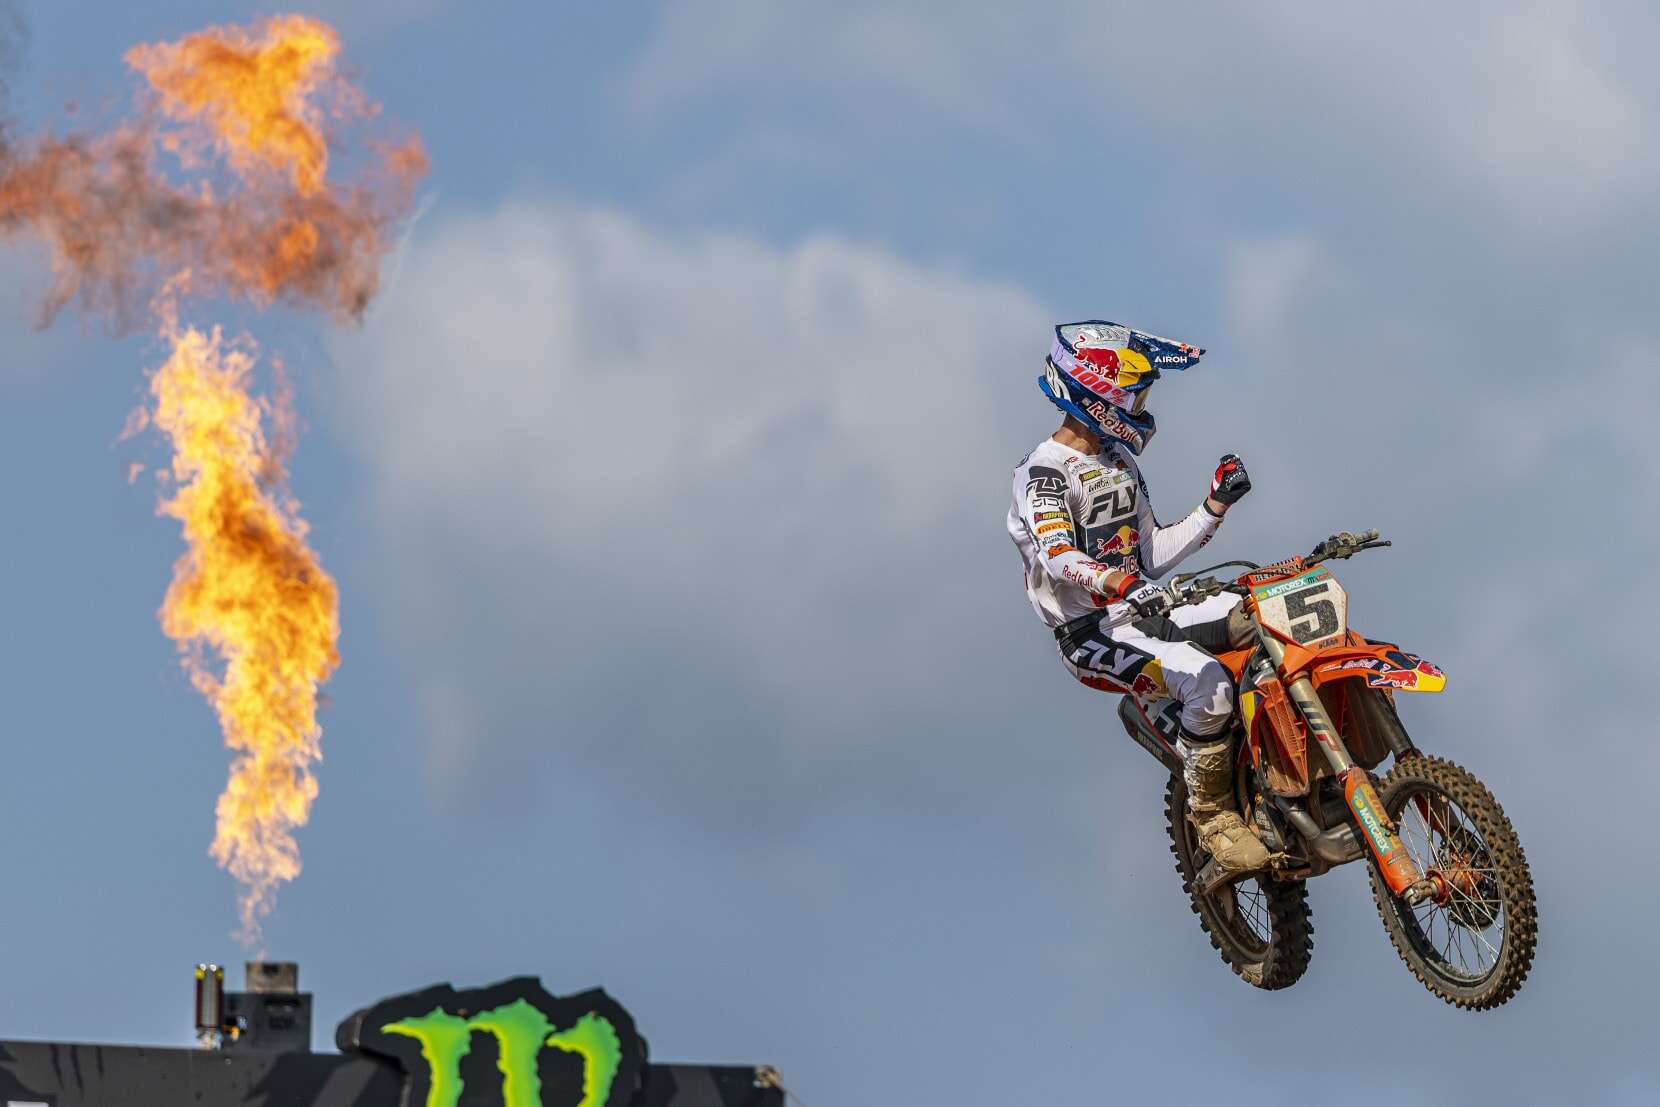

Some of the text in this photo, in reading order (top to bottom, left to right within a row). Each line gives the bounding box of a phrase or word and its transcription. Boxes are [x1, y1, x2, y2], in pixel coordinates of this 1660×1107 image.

[1155, 355, 1188, 364] AIROH
[1086, 401, 1141, 443] Red Bull
[1086, 483, 1138, 525] FLY
[1062, 564, 1078, 583] Red
[1266, 577, 1307, 597] MOTOREX
[1137, 585, 1161, 601] dbk
[1283, 582, 1340, 644] 5
[1359, 807, 1389, 853] MOTOREX
